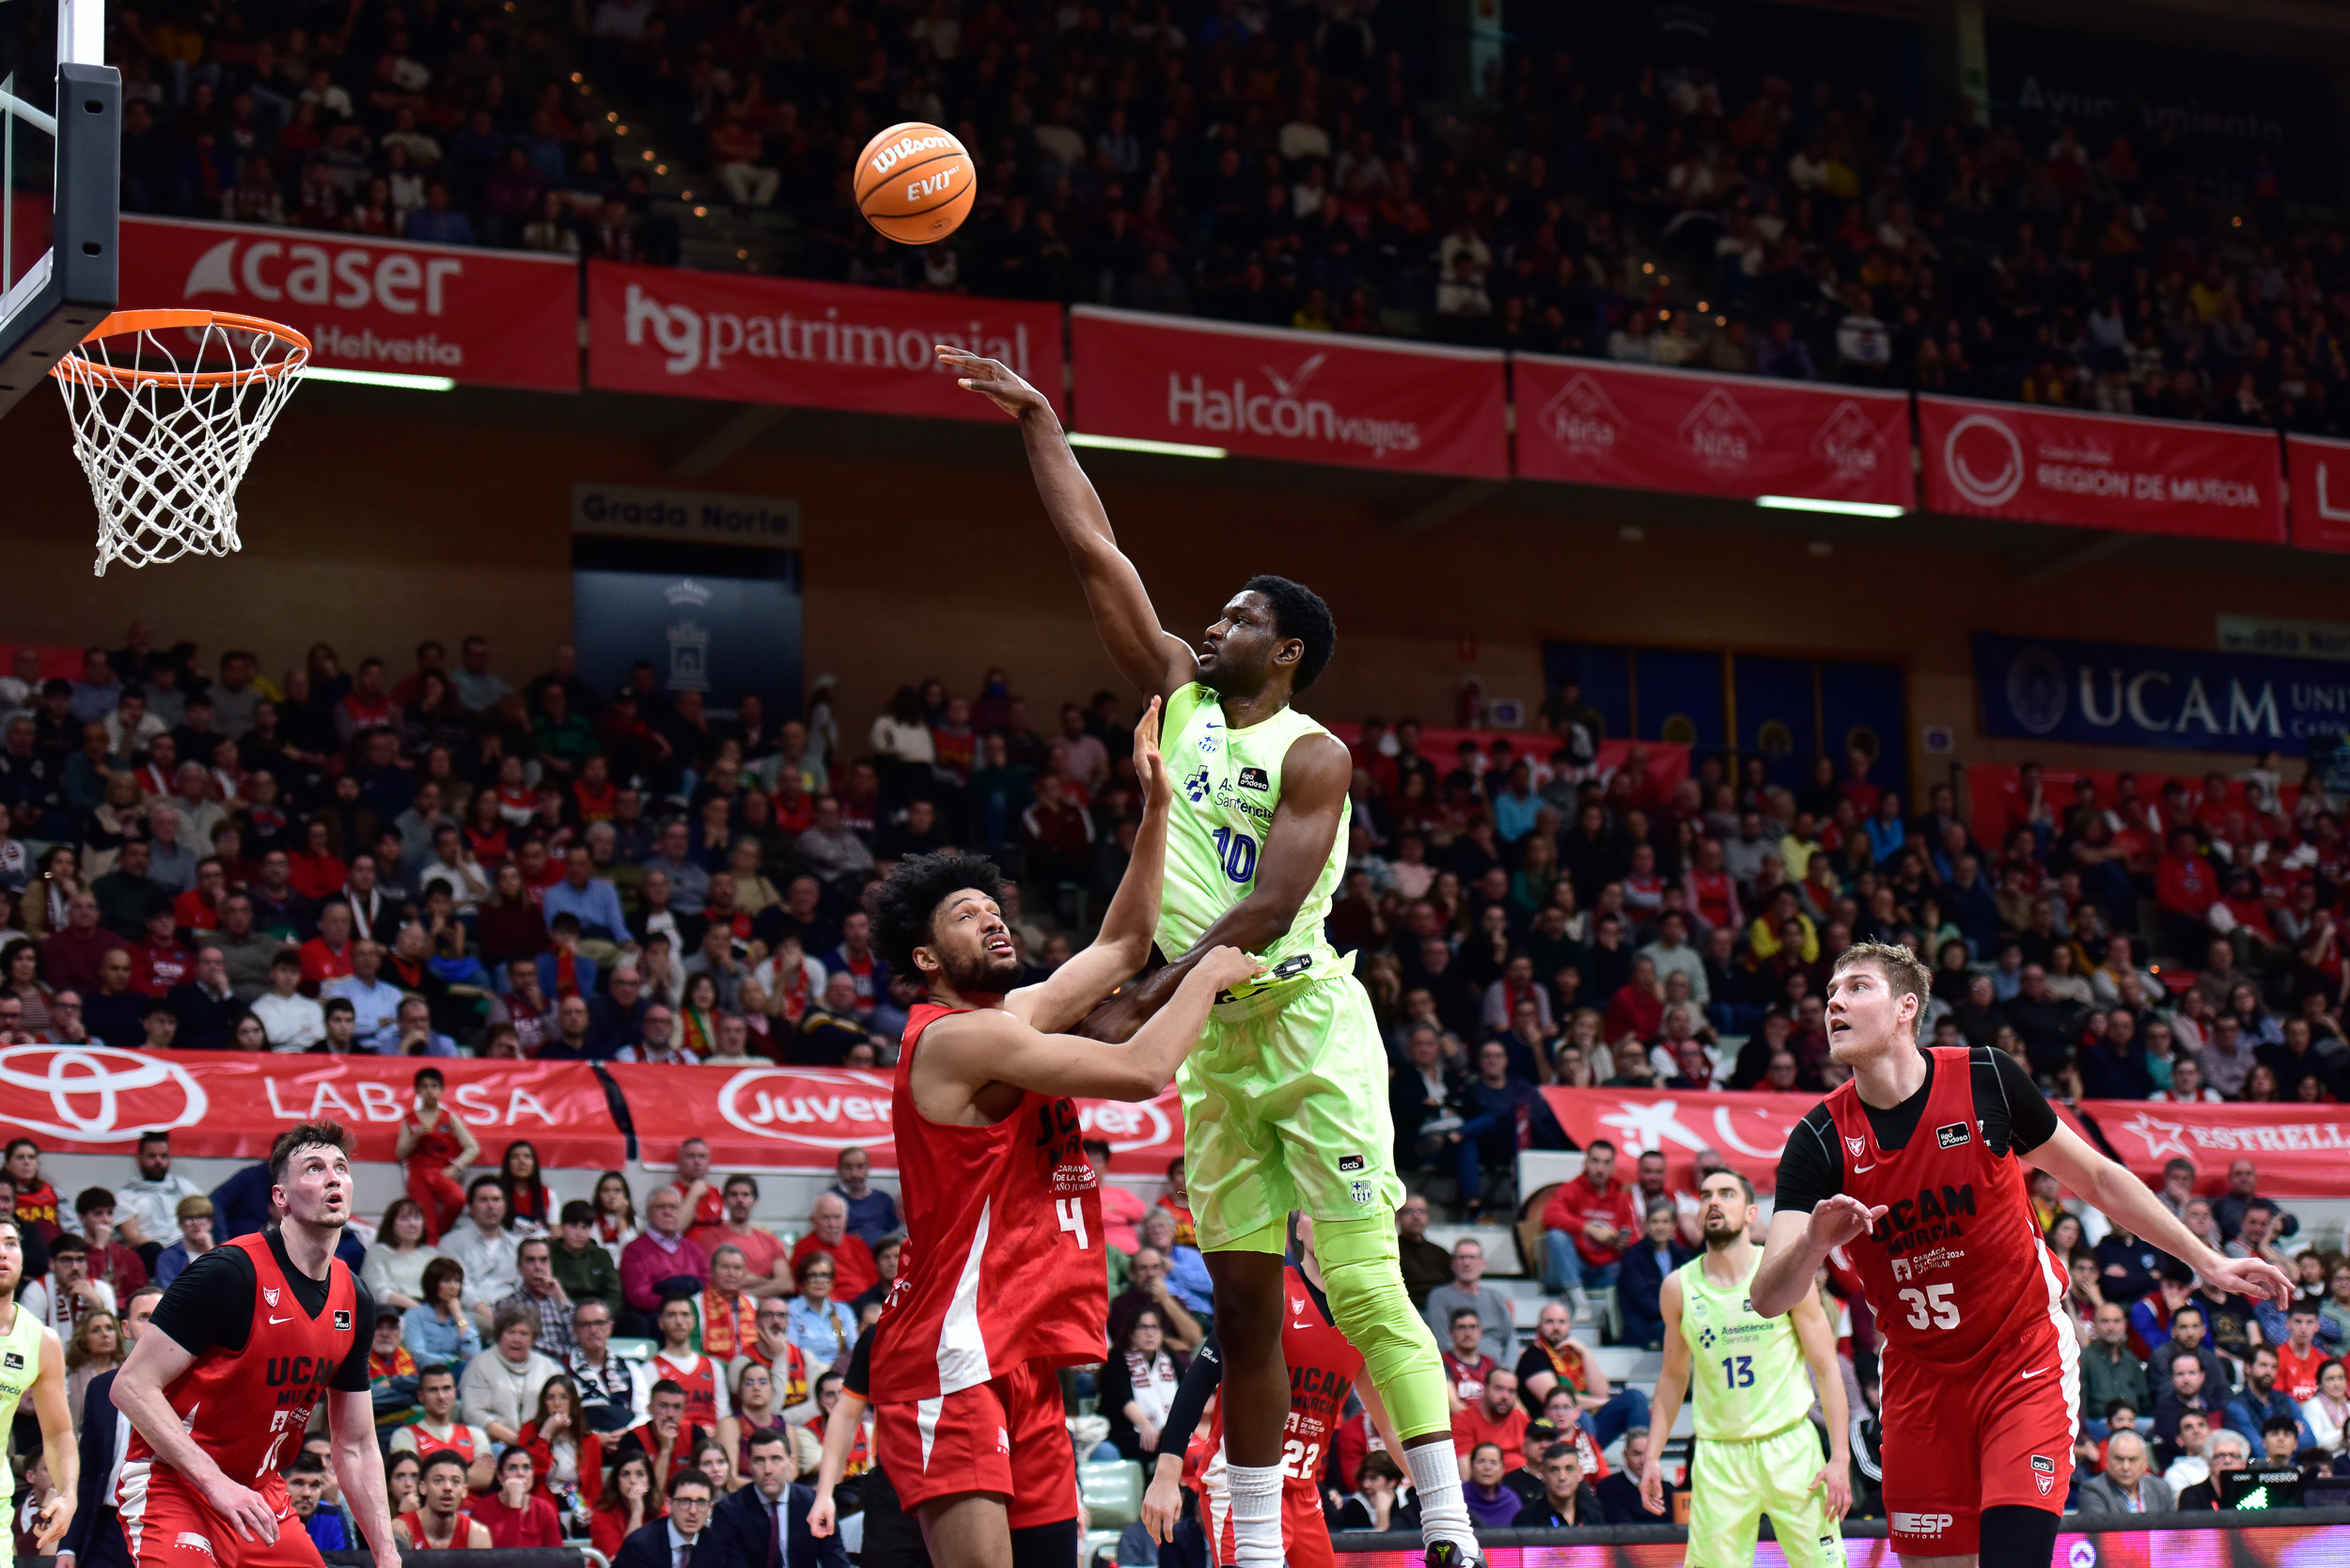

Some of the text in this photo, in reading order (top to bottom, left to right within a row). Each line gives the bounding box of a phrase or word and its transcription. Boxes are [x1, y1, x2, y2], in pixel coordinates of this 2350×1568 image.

[871, 136, 951, 173] Wilson
[242, 241, 462, 316] caser
[2133, 473, 2166, 501] DE
[2170, 477, 2261, 510] MURCIA
[582, 494, 789, 536] Grada Norte
[2079, 666, 2285, 740] UCAM
[2290, 681, 2350, 714] UNI
[1240, 779, 1268, 791] endesa
[1241, 772, 1255, 780] liga
[1212, 826, 1257, 884] 10
[265, 1076, 556, 1126] LABSA
[1940, 1132, 1954, 1141] liga
[2188, 1122, 2350, 1152] ESTRELL
[1341, 1161, 1359, 1170] acb
[1055, 1182, 1071, 1191] AÑO
[1056, 1197, 1089, 1250] 4
[1871, 1184, 1977, 1243] UCAM
[1888, 1221, 1963, 1256] MURCIA
[1946, 1249, 1965, 1259] 2024
[1898, 1282, 1961, 1330] 35
[1721, 1322, 1775, 1335] Assistència
[1721, 1355, 1755, 1389] 13
[1282, 1438, 1320, 1479] 22
[2033, 1460, 2050, 1470] acb
[1891, 1529, 1943, 1540] SOLUTIONS
[1897, 1513, 1953, 1533] ESP
